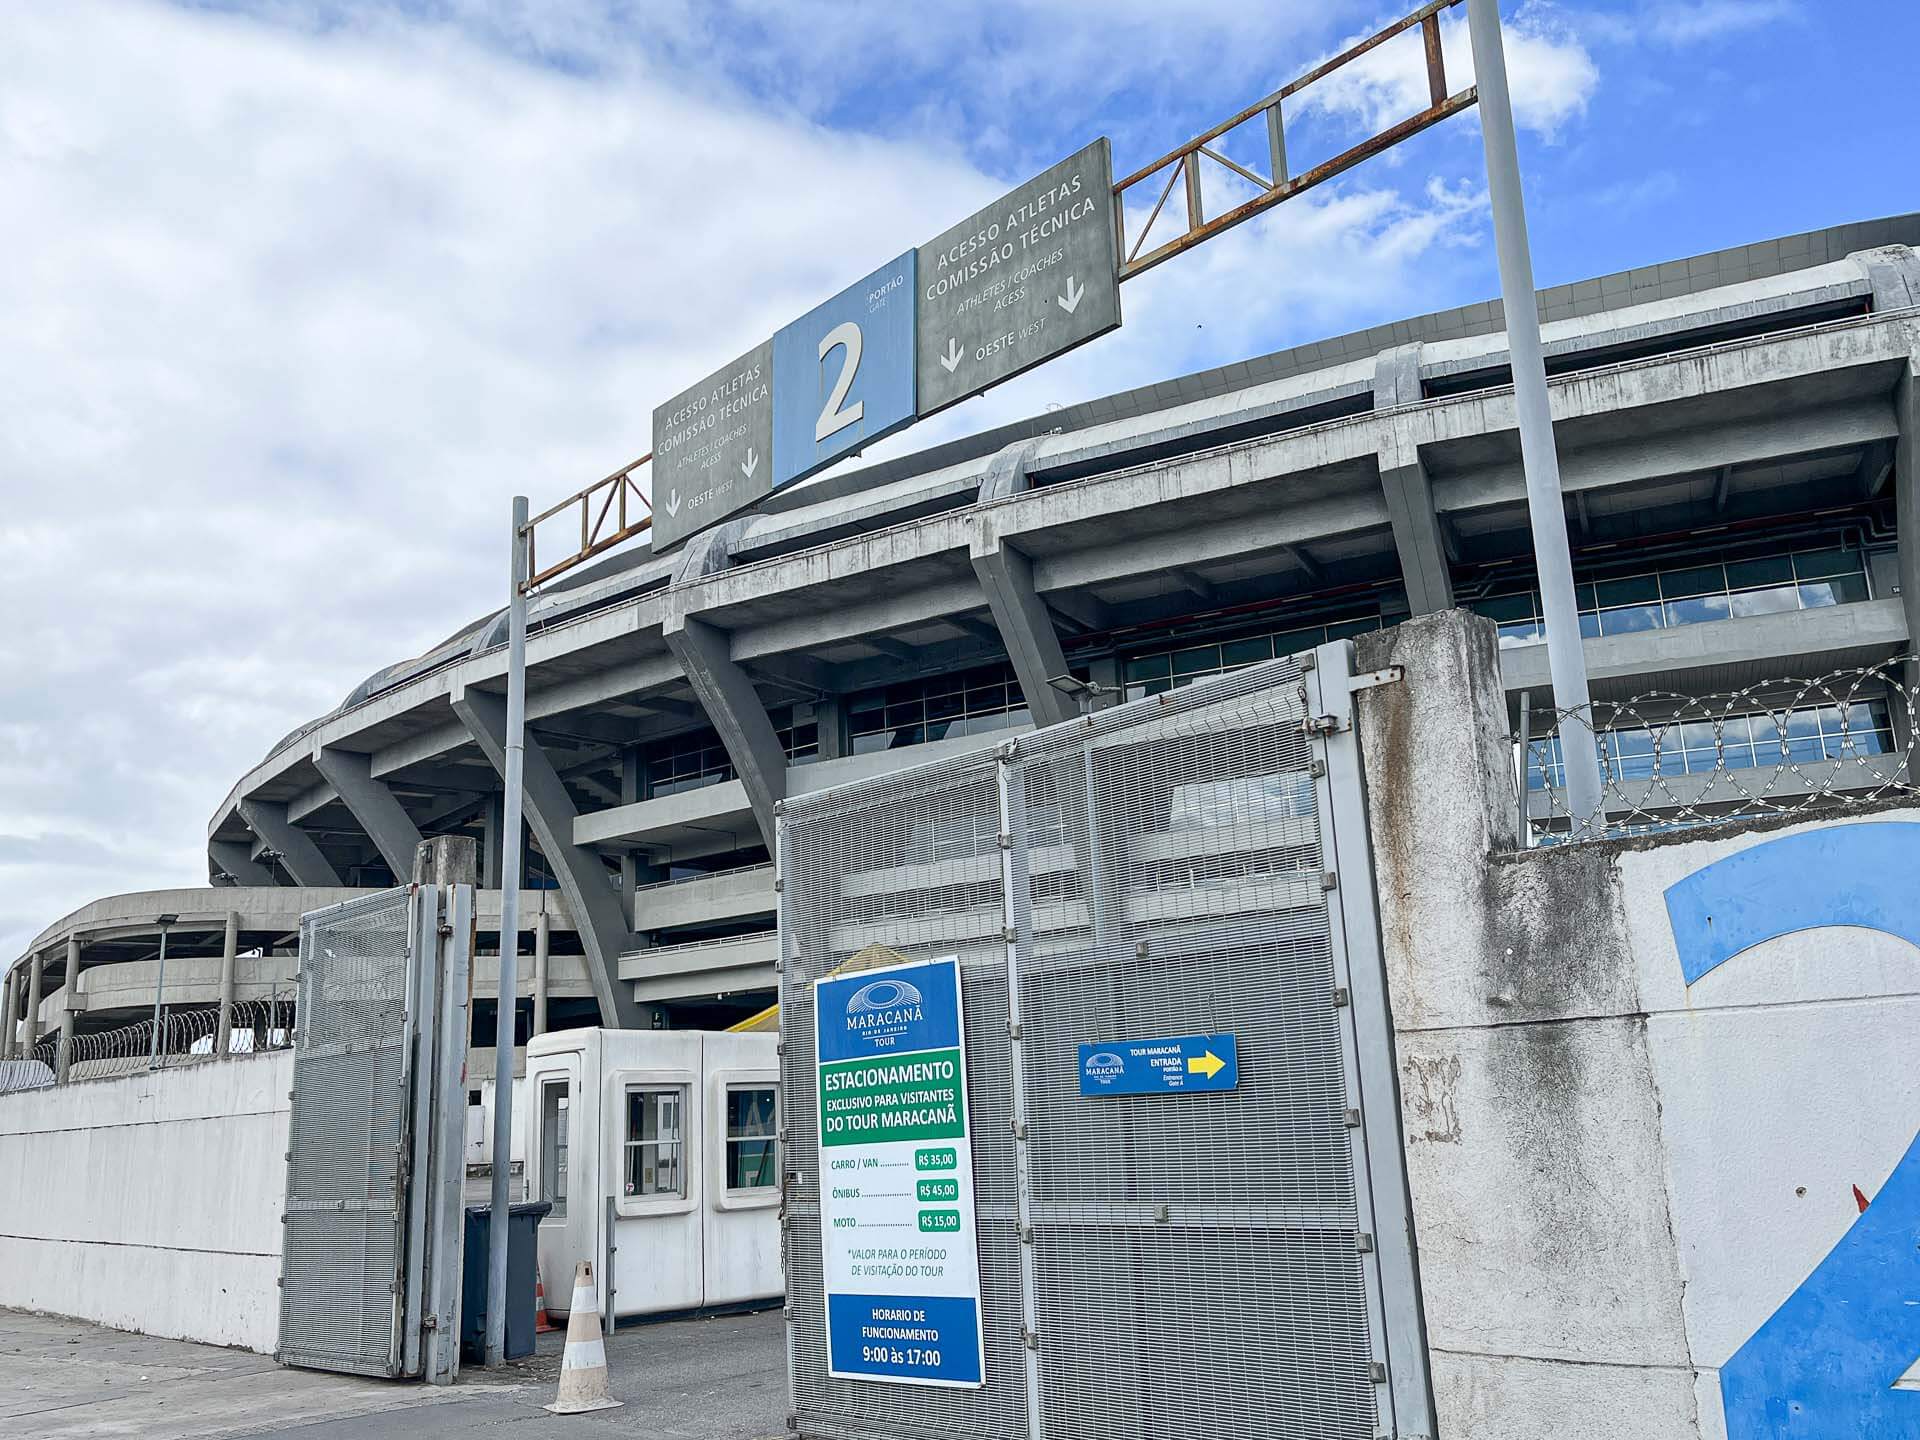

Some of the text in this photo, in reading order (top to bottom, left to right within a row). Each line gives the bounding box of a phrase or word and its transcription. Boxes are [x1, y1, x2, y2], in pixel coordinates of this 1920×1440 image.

[938, 174, 1082, 271] ACESSO ATLETAS
[926, 197, 1096, 301] COMISSÃO TÉCNICA
[956, 280, 1006, 315] ATHLETES
[1014, 248, 1064, 284] COACHES
[994, 286, 1025, 312] ACESS
[976, 317, 1048, 361] OESTE WEST
[816, 322, 864, 443] 2
[665, 364, 761, 431] ACESSO ATLETAS
[658, 383, 768, 456] COMISSÃO TÉCNICA
[676, 445, 710, 471] ATHLETES
[714, 423, 748, 450] COACHES
[700, 452, 722, 470] ACESS
[687, 479, 733, 510] OESTE WEST
[846, 1004, 924, 1030] MARACANÃ
[874, 1037, 896, 1048] TOUR
[1130, 1044, 1181, 1056] TOUR MARACANÃ
[1150, 1057, 1182, 1067] ENTRADA
[825, 1060, 954, 1092] ESTACIONAMENTO
[826, 1088, 954, 1112] EXCLUSIVO PARA VISITANTES
[826, 1104, 957, 1132] DO TOUR MARACANÃ
[831, 1160, 856, 1170] CARRO
[862, 1158, 878, 1168] VAN
[918, 1152, 928, 1166] R$
[930, 1154, 954, 1166] 35,00
[832, 1184, 955, 1199] ÔNIBUS R$ 45,00
[834, 1215, 957, 1228] MOTO R$ 15,00
[878, 1248, 898, 1260] PARA
[900, 1249, 907, 1260] O
[909, 1246, 947, 1260] PERÍODO
[851, 1263, 944, 1278] DE VISITAÇÃO DO TOUR
[872, 1308, 926, 1322] HORARIO DE
[862, 1326, 939, 1342] FUNCIONAMENTO
[862, 1346, 941, 1366] 9:00 às 17:00
